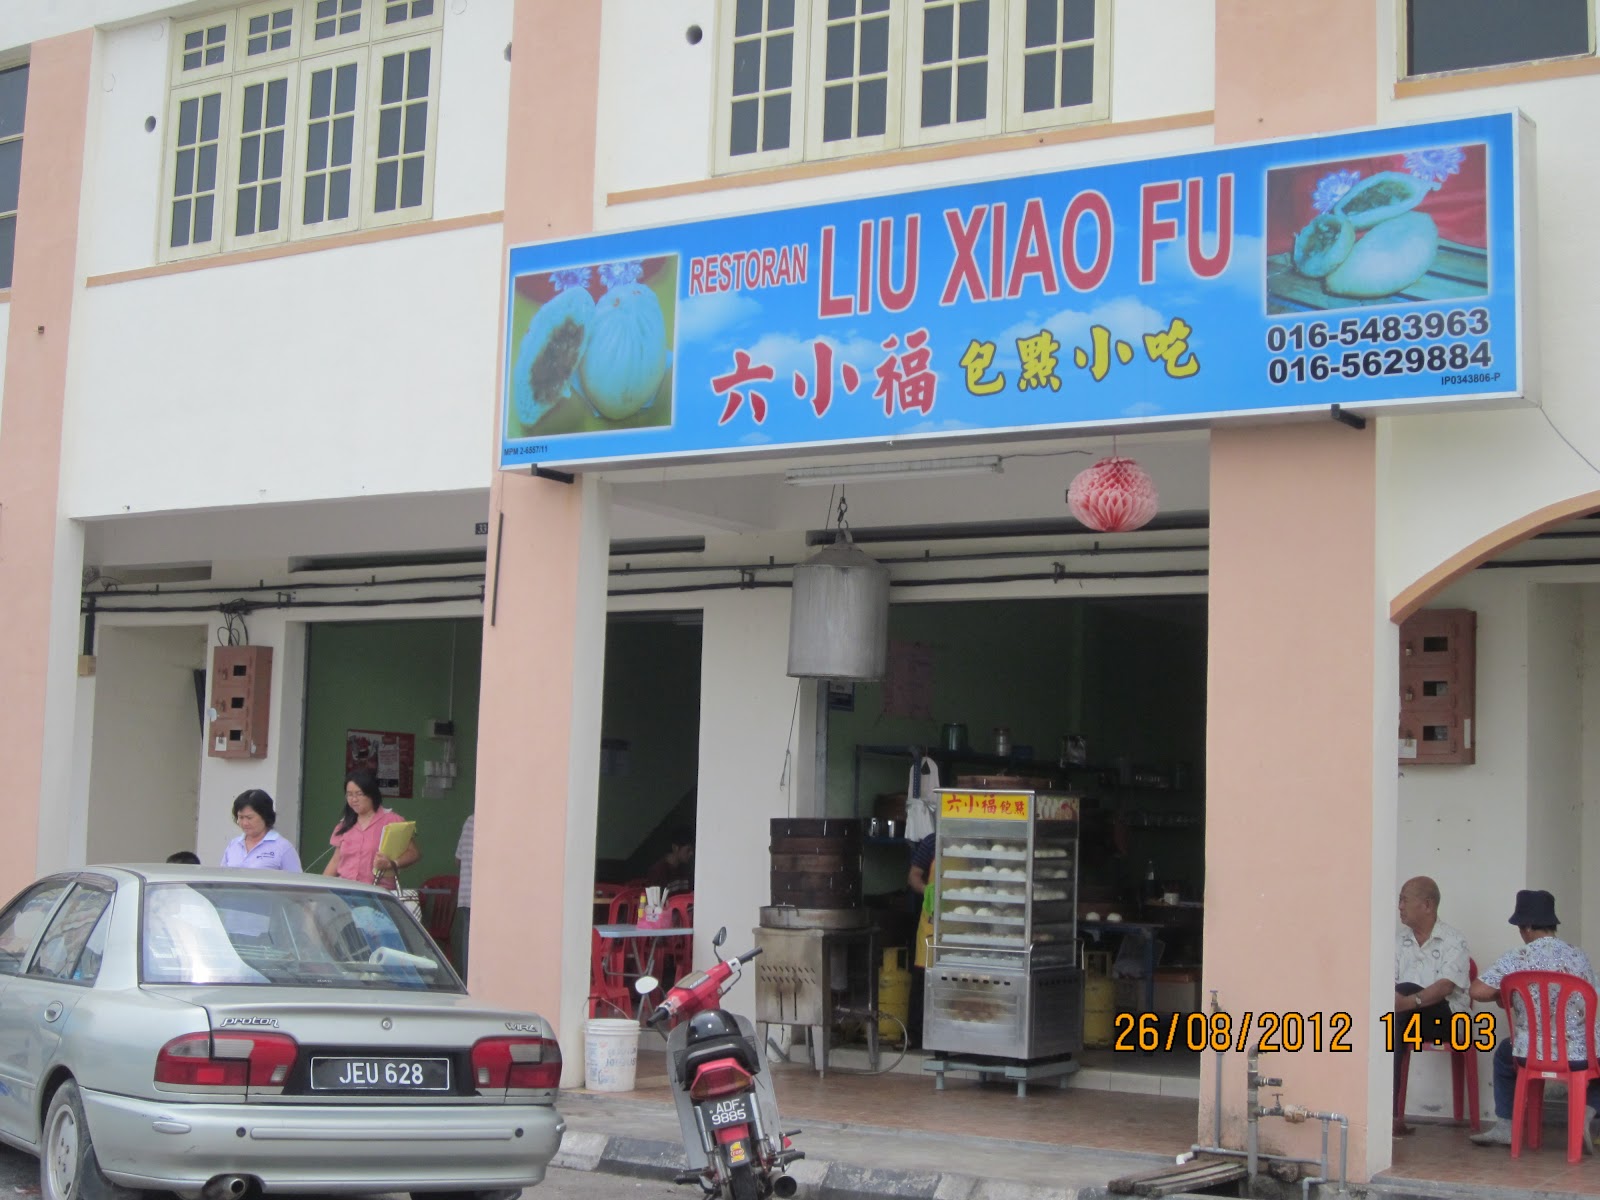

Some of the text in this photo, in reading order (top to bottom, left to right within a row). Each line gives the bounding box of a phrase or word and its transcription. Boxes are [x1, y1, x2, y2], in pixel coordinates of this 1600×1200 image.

[689, 173, 1234, 319] RESTORAN LIU XIAO FU
[1267, 308, 1490, 352] 016-5483963
[711, 317, 1201, 426] 六小福 包點小吃
[1269, 341, 1492, 384] 016-5629884
[1441, 373, 1501, 386] IP0343806-P
[504, 447, 519, 456] MPM
[220, 1016, 280, 1028] proton
[505, 1022, 538, 1033] WIRA
[339, 1062, 423, 1085] JEU 628
[712, 1098, 746, 1125] ADF 9885
